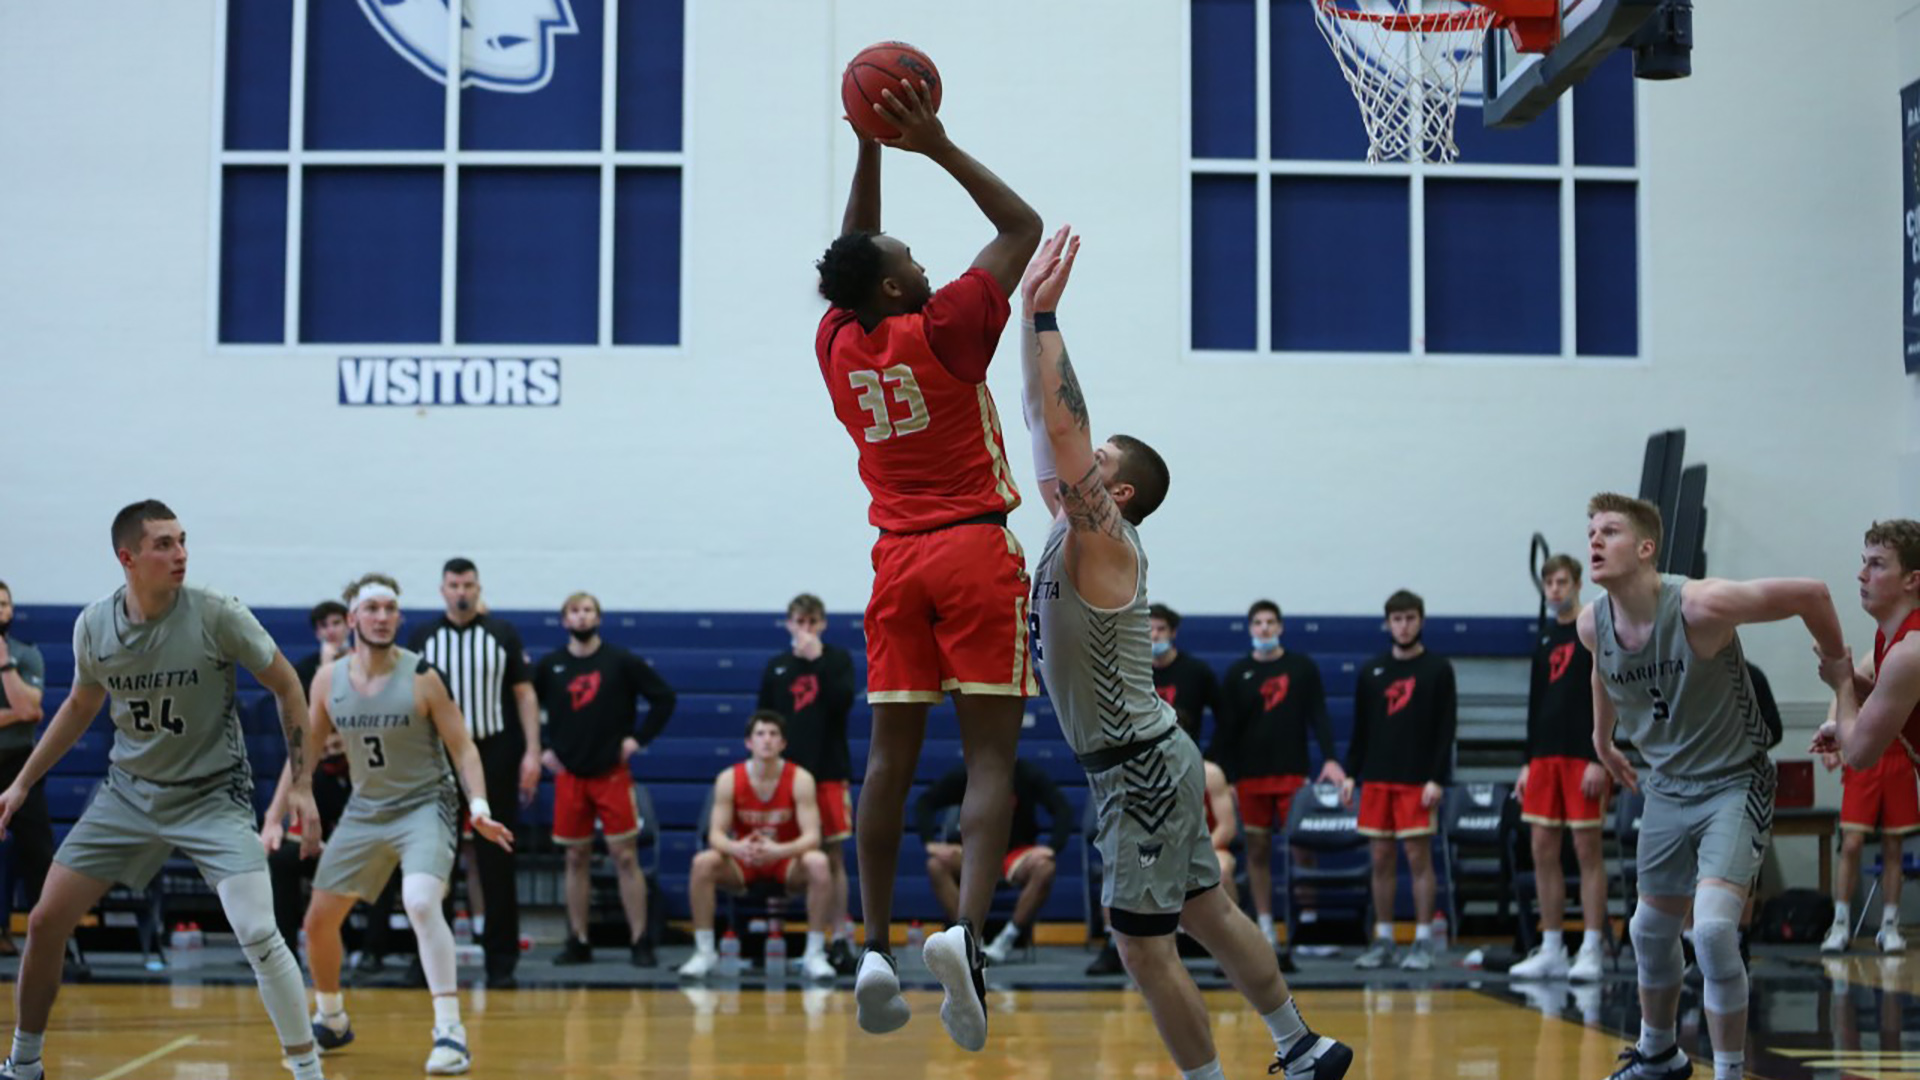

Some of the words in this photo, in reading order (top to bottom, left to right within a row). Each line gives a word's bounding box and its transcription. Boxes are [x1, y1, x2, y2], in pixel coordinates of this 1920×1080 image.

[341, 358, 560, 405] VISITORS
[848, 363, 931, 443] 33
[107, 669, 199, 691] MARIETTA
[128, 698, 186, 736] 24
[335, 713, 411, 729] MARIETTA
[362, 735, 387, 770] 3
